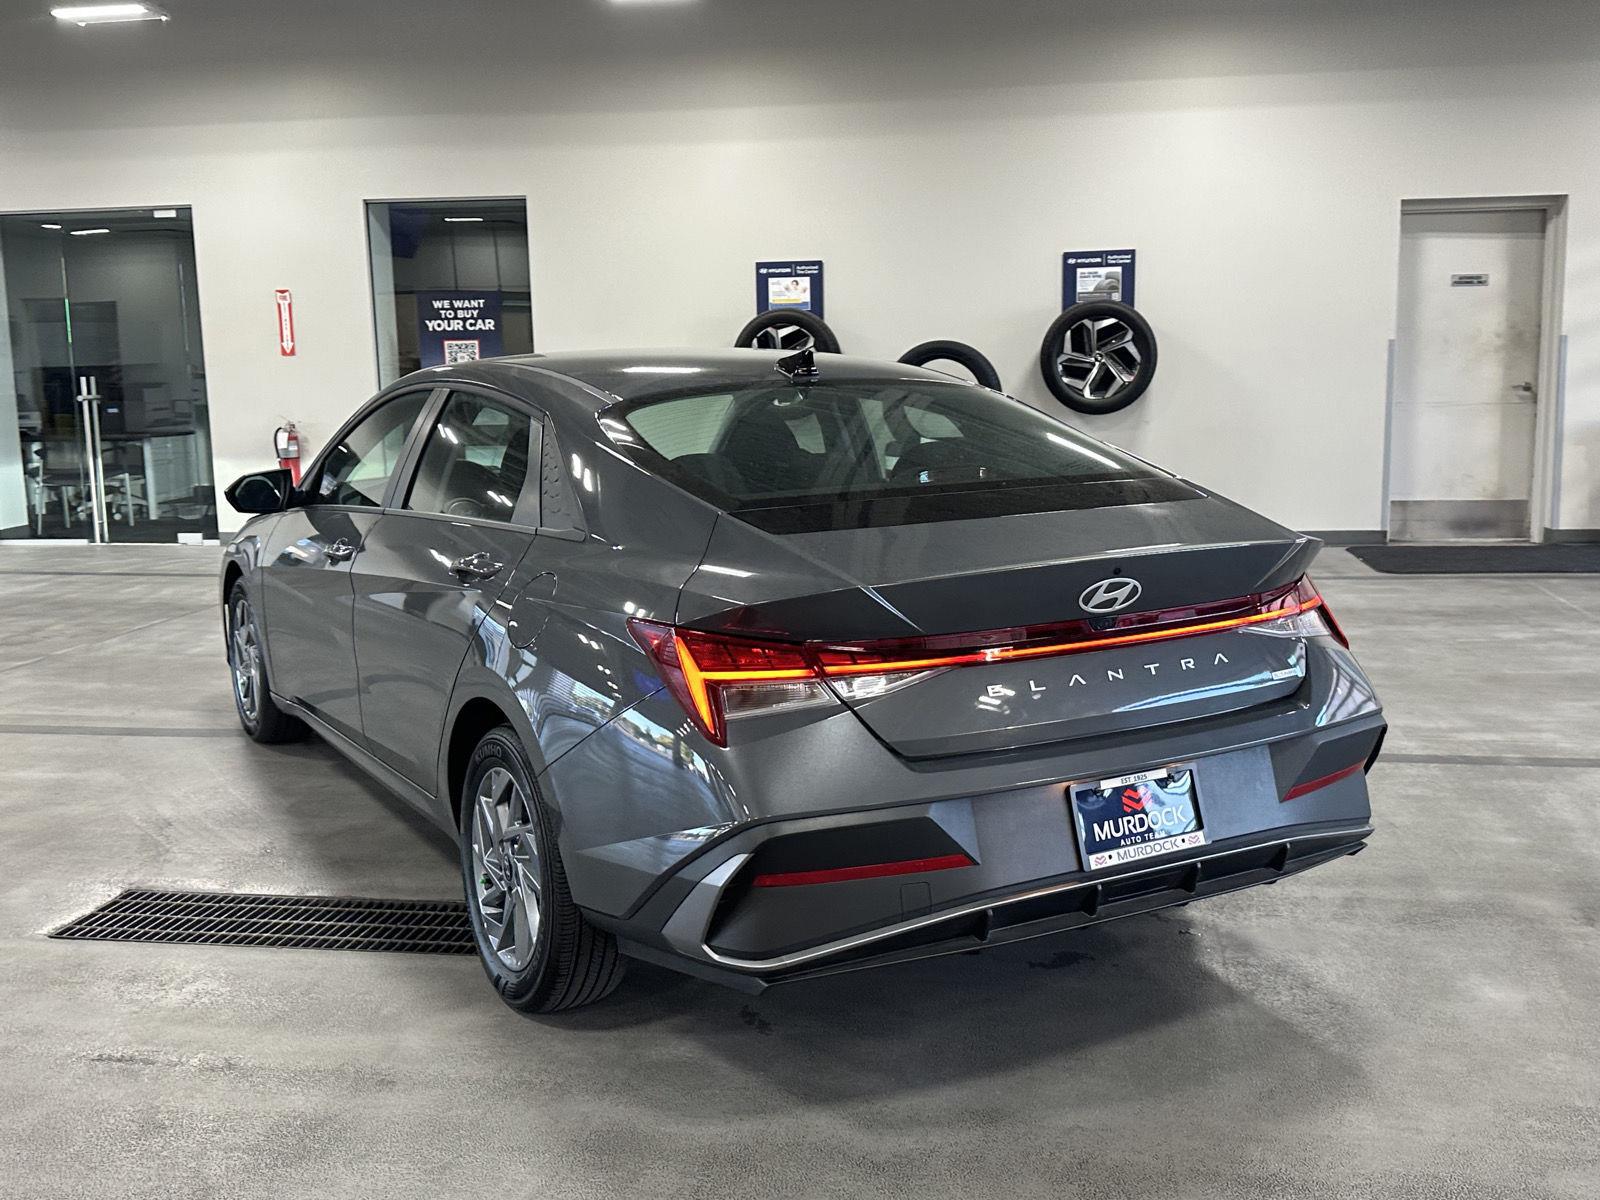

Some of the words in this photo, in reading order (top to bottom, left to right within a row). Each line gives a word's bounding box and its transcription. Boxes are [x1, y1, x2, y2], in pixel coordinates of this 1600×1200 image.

[432, 300, 450, 308] WE
[452, 299, 485, 308] WANT
[439, 310, 455, 318] TO
[457, 309, 479, 317] BUY
[425, 320, 464, 331] YOUR
[465, 319, 495, 330] CAR
[986, 653, 1229, 697] ELANTRA
[1134, 774, 1148, 782] 1925
[1092, 804, 1186, 842] MURDOCK
[1120, 836, 1142, 847] AUTO
[1144, 831, 1166, 841] TEAM
[1117, 838, 1180, 862] MURDOCK
